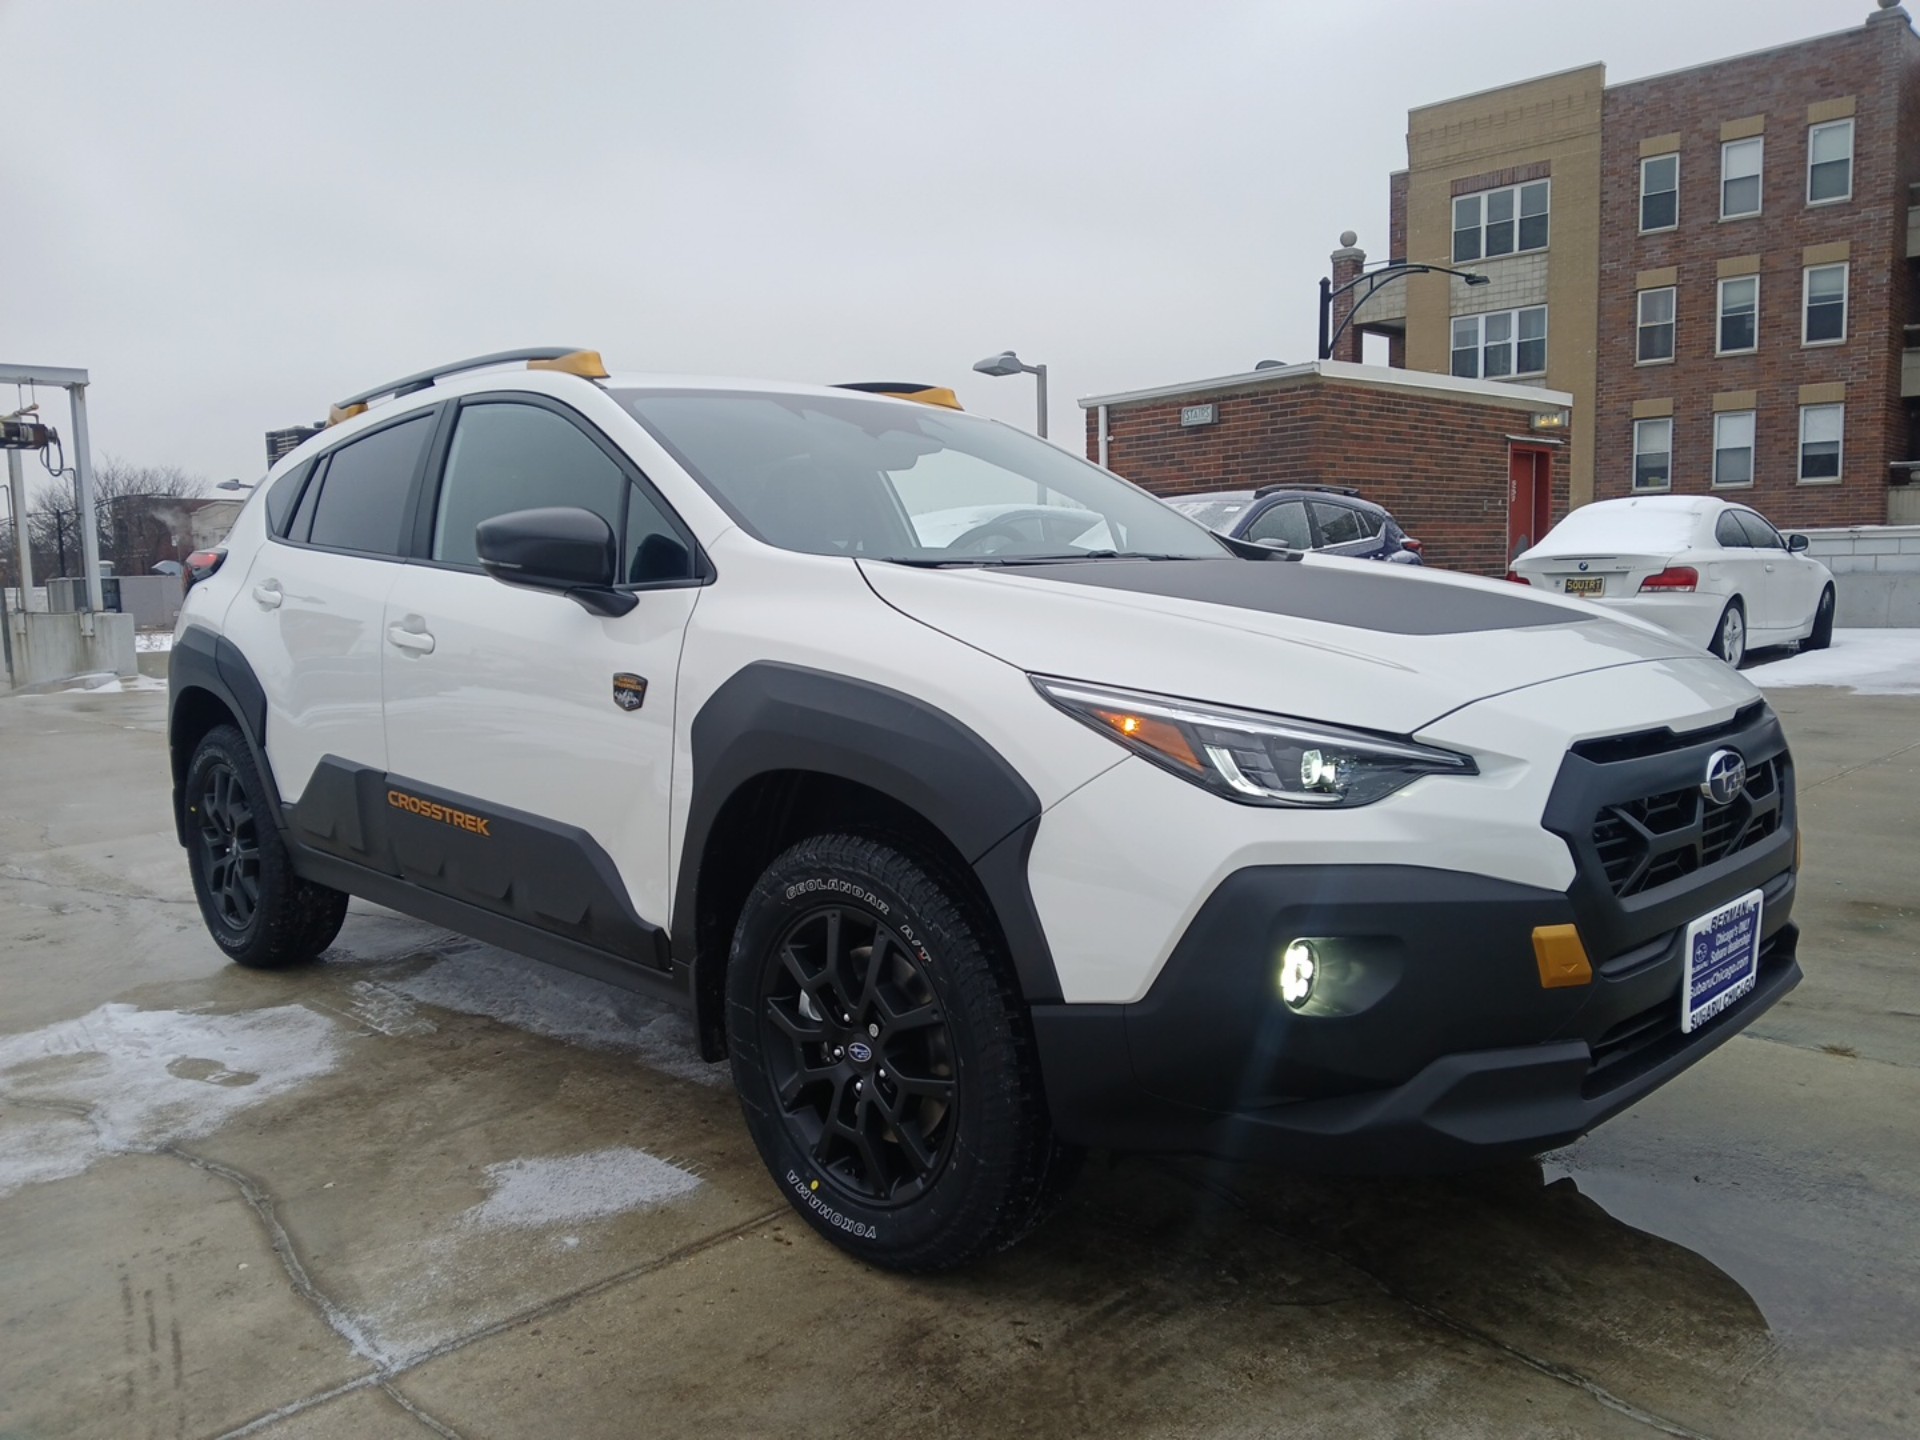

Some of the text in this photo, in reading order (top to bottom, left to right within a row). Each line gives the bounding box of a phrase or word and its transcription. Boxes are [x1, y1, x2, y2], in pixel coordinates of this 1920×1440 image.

[387, 790, 491, 837] CROSSTREK
[786, 878, 932, 962] GEOLANDAR A/T
[786, 1169, 877, 1239] YOKOHAMA
